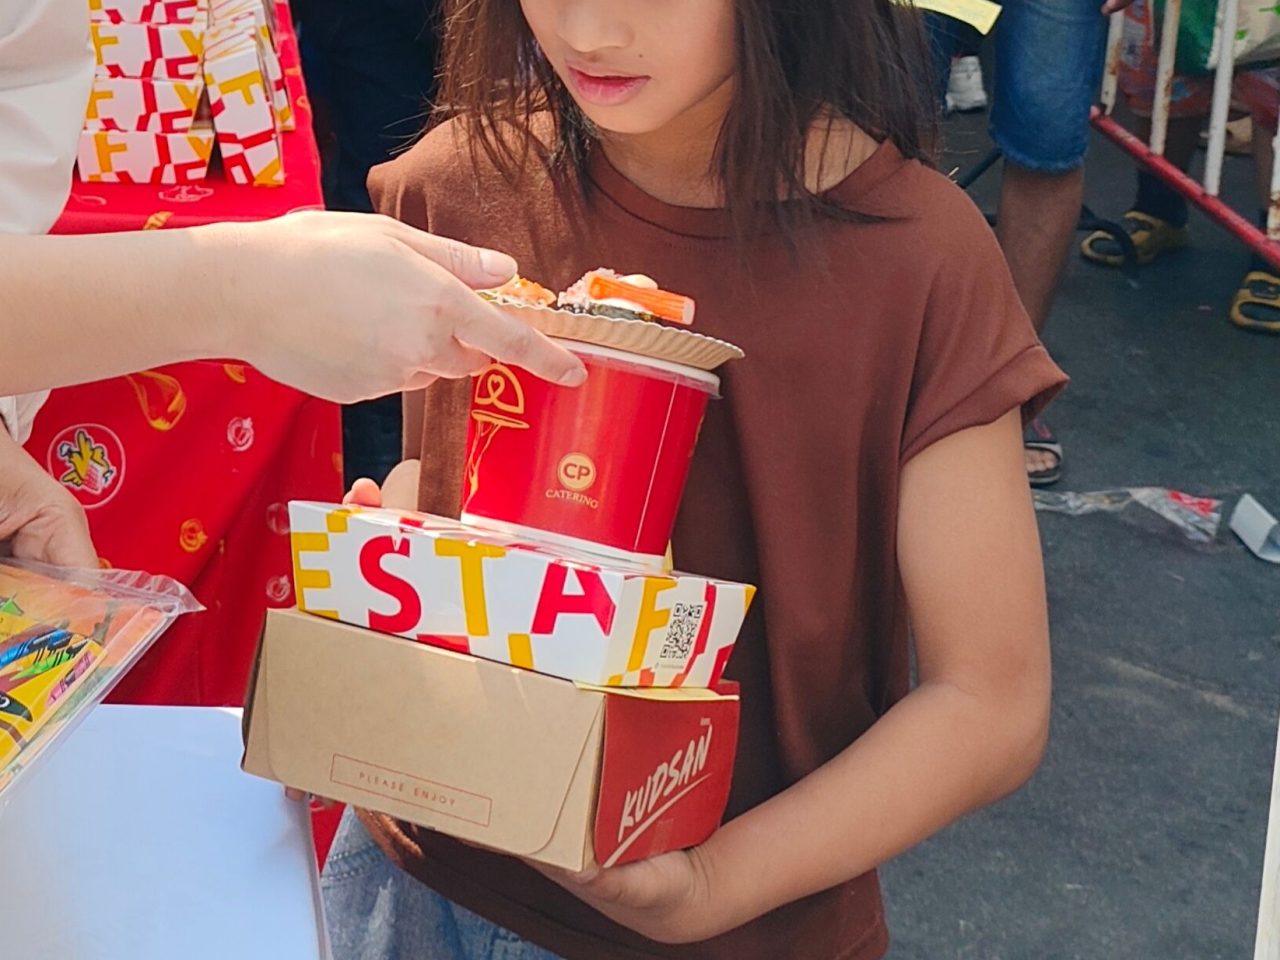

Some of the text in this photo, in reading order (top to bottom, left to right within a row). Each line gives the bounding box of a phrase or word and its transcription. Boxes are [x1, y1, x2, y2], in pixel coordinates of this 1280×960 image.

[563, 463, 591, 480] CP
[545, 489, 599, 509] CATERING
[359, 772, 456, 807] PLEASE ENJOY
[618, 717, 713, 843] KUDSAN
